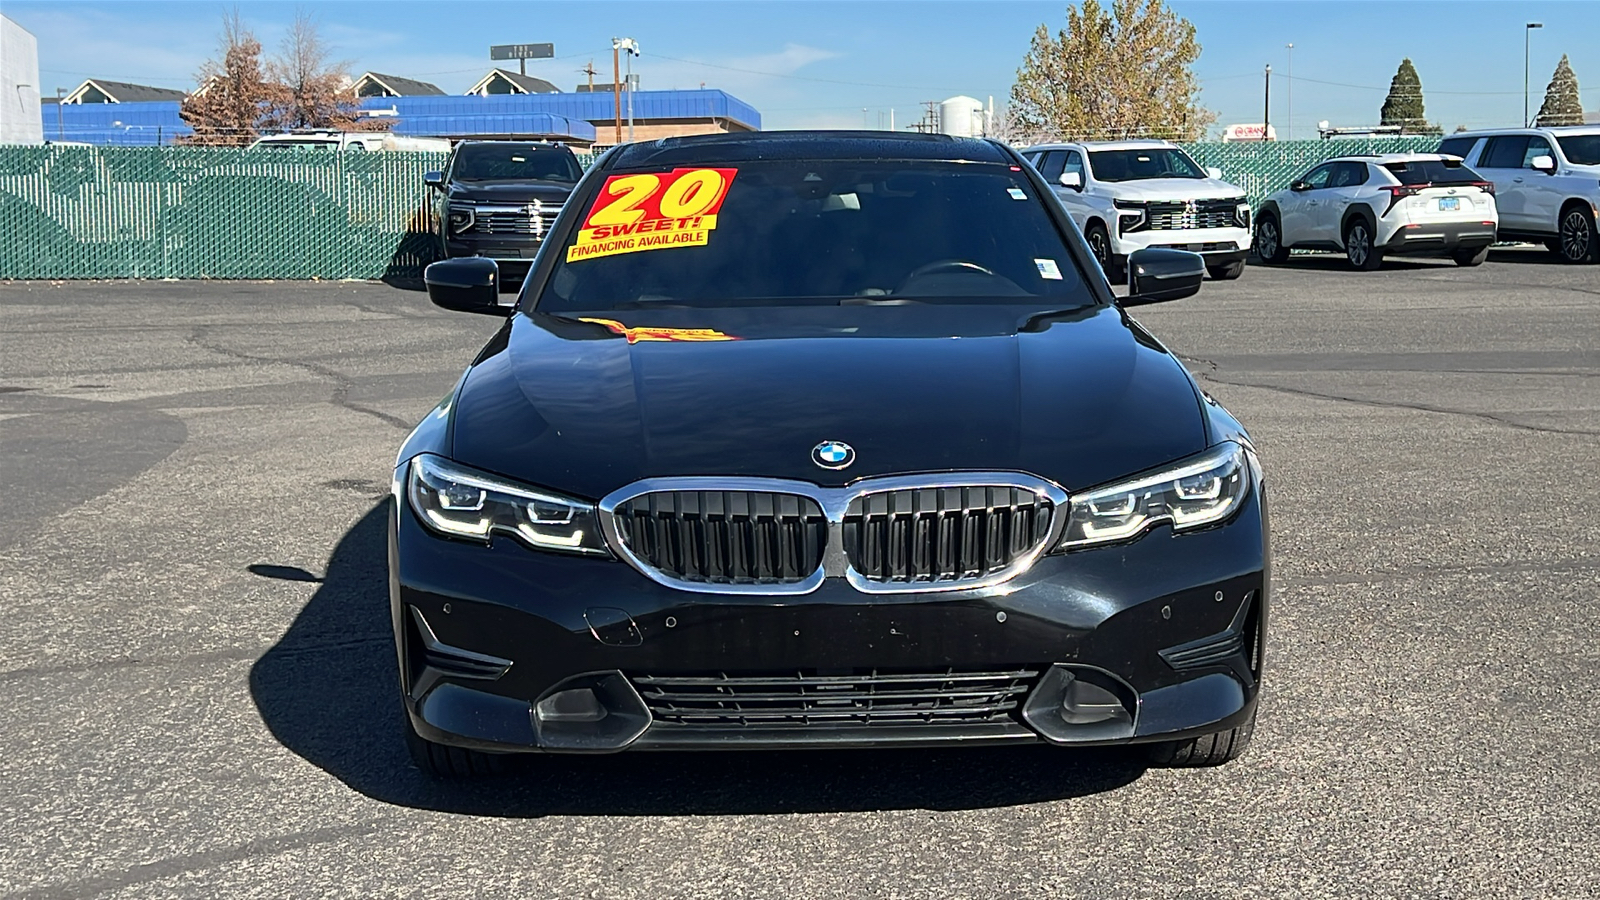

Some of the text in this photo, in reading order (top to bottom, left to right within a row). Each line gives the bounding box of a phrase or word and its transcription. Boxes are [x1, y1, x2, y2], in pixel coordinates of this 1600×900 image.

[589, 169, 726, 226] 20
[590, 215, 702, 240] SWEET!
[571, 231, 704, 258] FINANCING AVAILABLE
